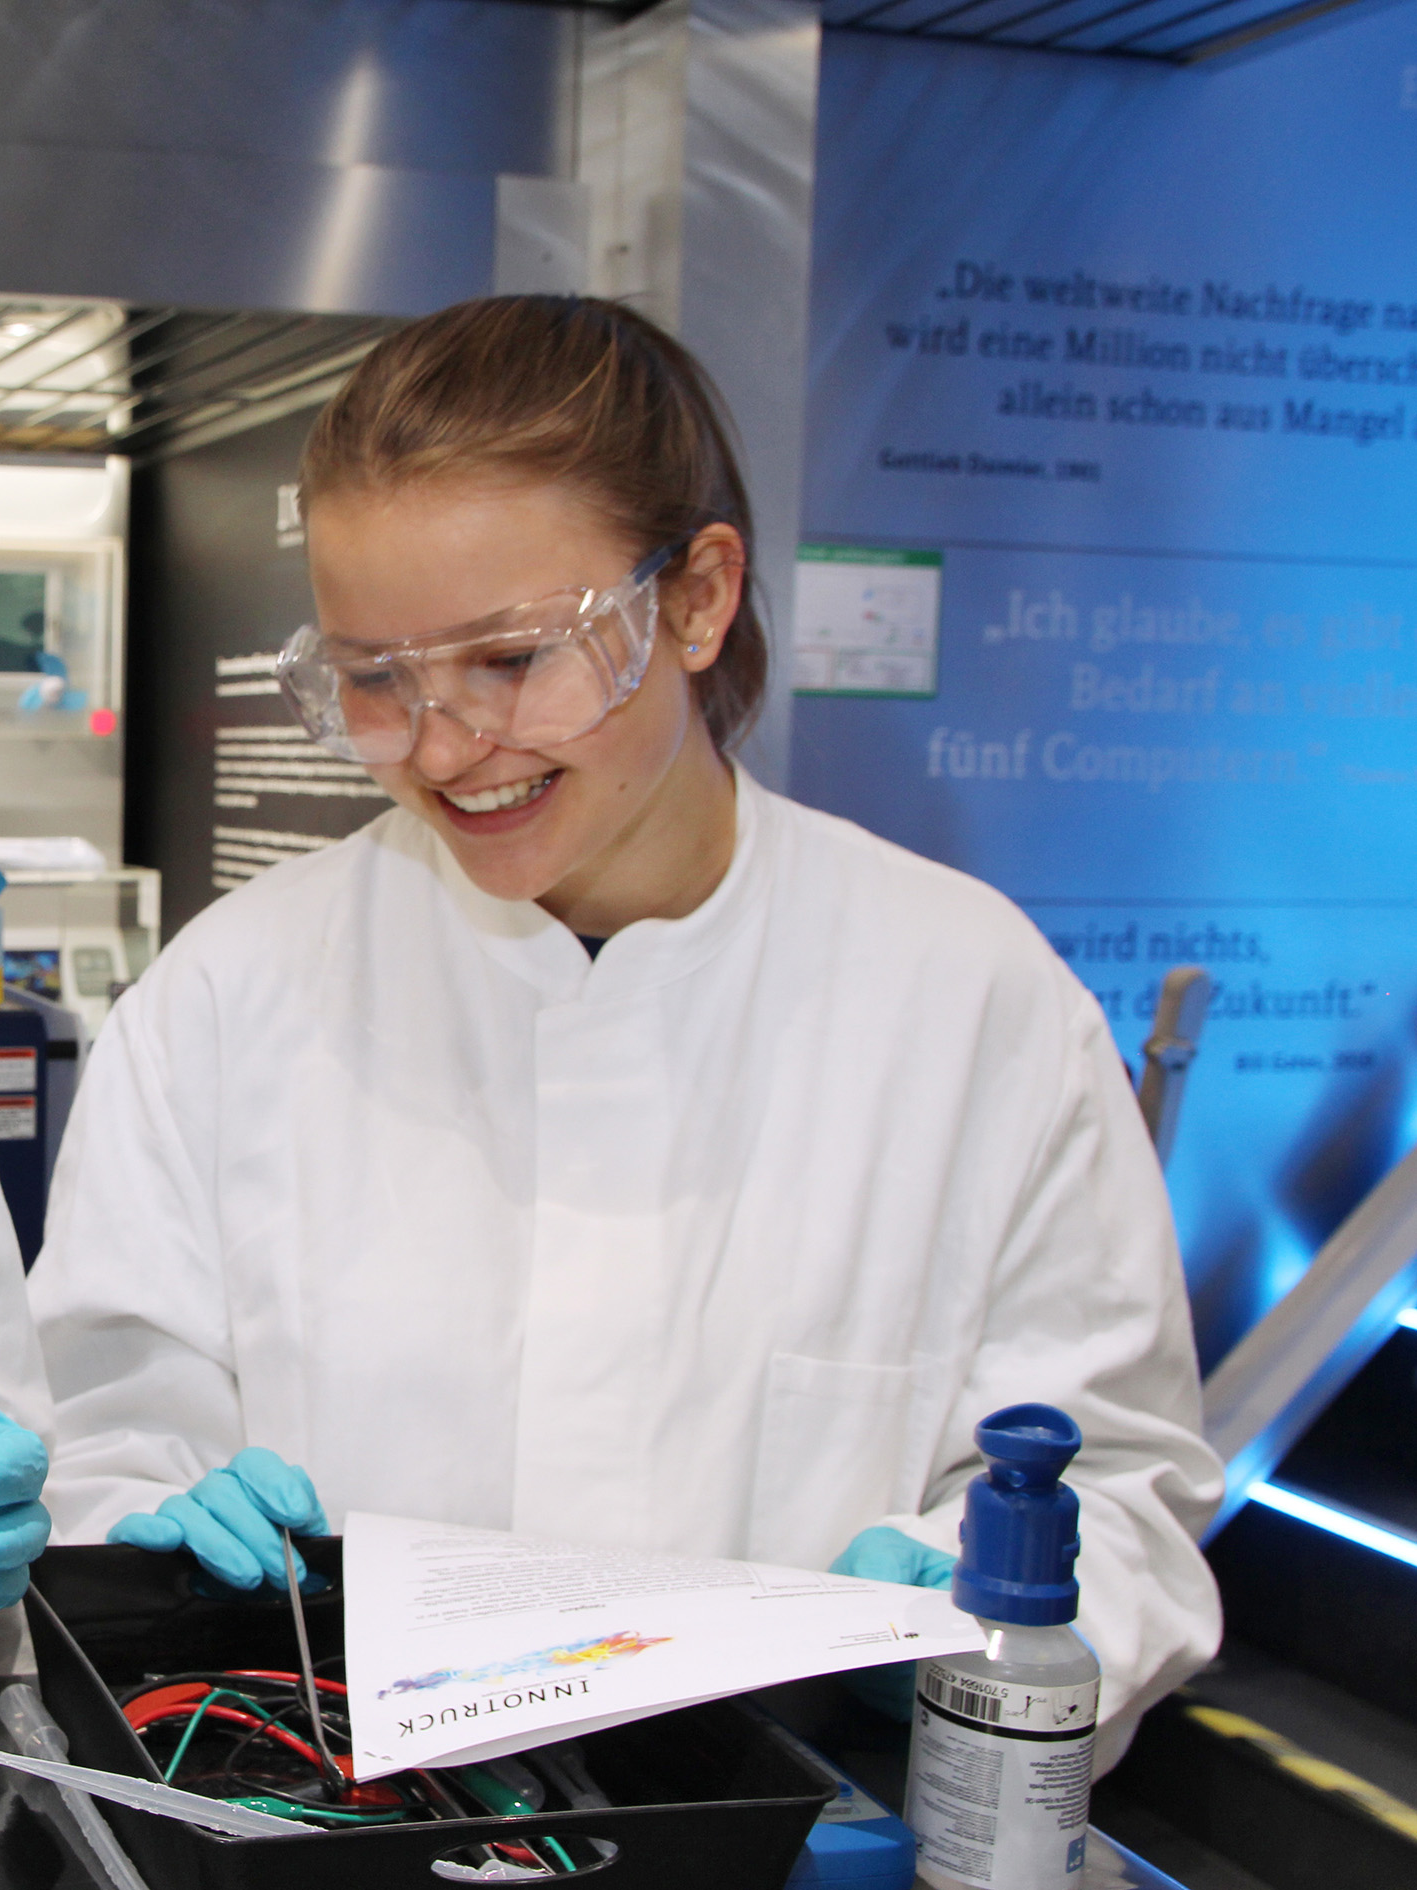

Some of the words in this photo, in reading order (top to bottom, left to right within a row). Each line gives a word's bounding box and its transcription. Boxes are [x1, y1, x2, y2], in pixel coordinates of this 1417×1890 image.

[1024, 272, 1191, 317] weltweite
[1200, 279, 1373, 336] Nachfrage
[884, 317, 970, 357] wird
[979, 322, 1054, 361] eine
[1065, 328, 1190, 373] Million
[1200, 337, 1288, 378] nicht
[998, 380, 1098, 421] allein
[1108, 389, 1206, 428] schon
[1216, 402, 1272, 432] aus
[1283, 398, 1404, 447] Mangel
[1070, 663, 1223, 714] Bedarf
[926, 727, 1031, 780] fünf
[1147, 922, 1271, 967] nichts,
[397, 1678, 591, 1739] INNOTRUCK
[1000, 1687, 1009, 1699] 5
